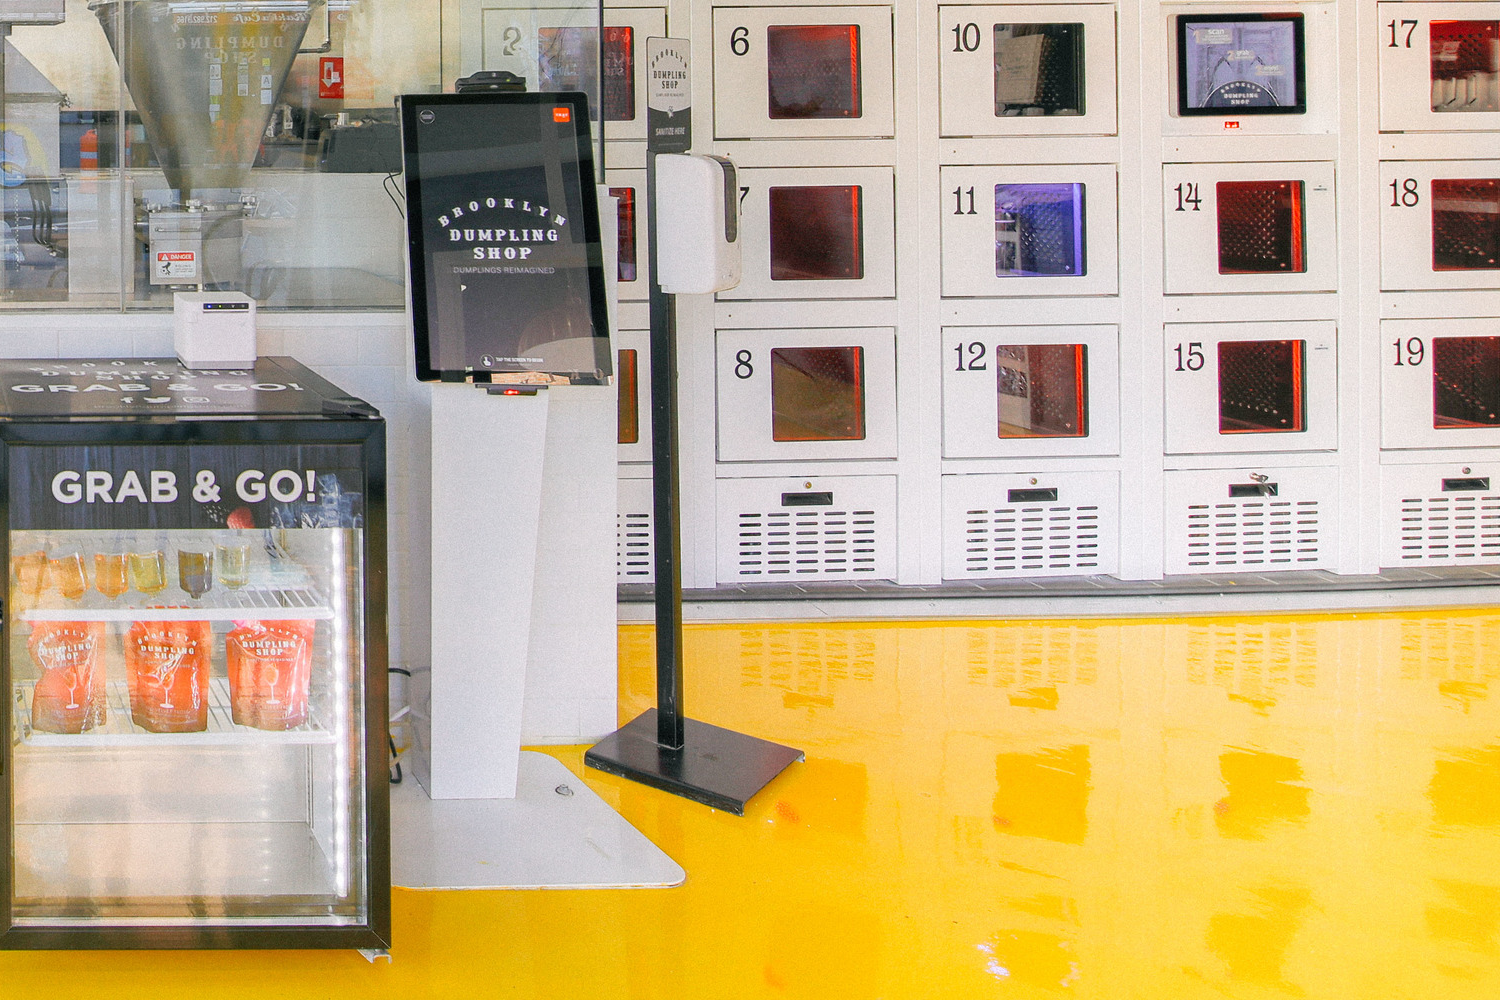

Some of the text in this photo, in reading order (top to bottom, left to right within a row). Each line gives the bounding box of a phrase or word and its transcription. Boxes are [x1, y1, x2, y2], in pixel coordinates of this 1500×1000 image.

[730, 26, 750, 56] 6
[952, 23, 981, 53] 10
[1387, 19, 1418, 48] 17
[654, 71, 686, 79] DUMPLING
[662, 81, 678, 89] SHOP
[953, 185, 977, 215] 11
[1174, 182, 1202, 212] 14
[1389, 178, 1420, 208] 18
[438, 197, 566, 228] BROOKLYN
[449, 229, 558, 241] DUMPLING
[473, 247, 532, 260] SHOP
[734, 349, 754, 380] 8
[954, 342, 987, 372] 12
[1174, 342, 1205, 372] 15
[1393, 337, 1425, 367] 19
[11, 383, 150, 392] GRAB
[214, 383, 304, 391] GO!
[51, 469, 316, 503] GRAB & GO!
[140, 645, 195, 655] DUMPLING
[242, 641, 297, 649] DUMPLING
